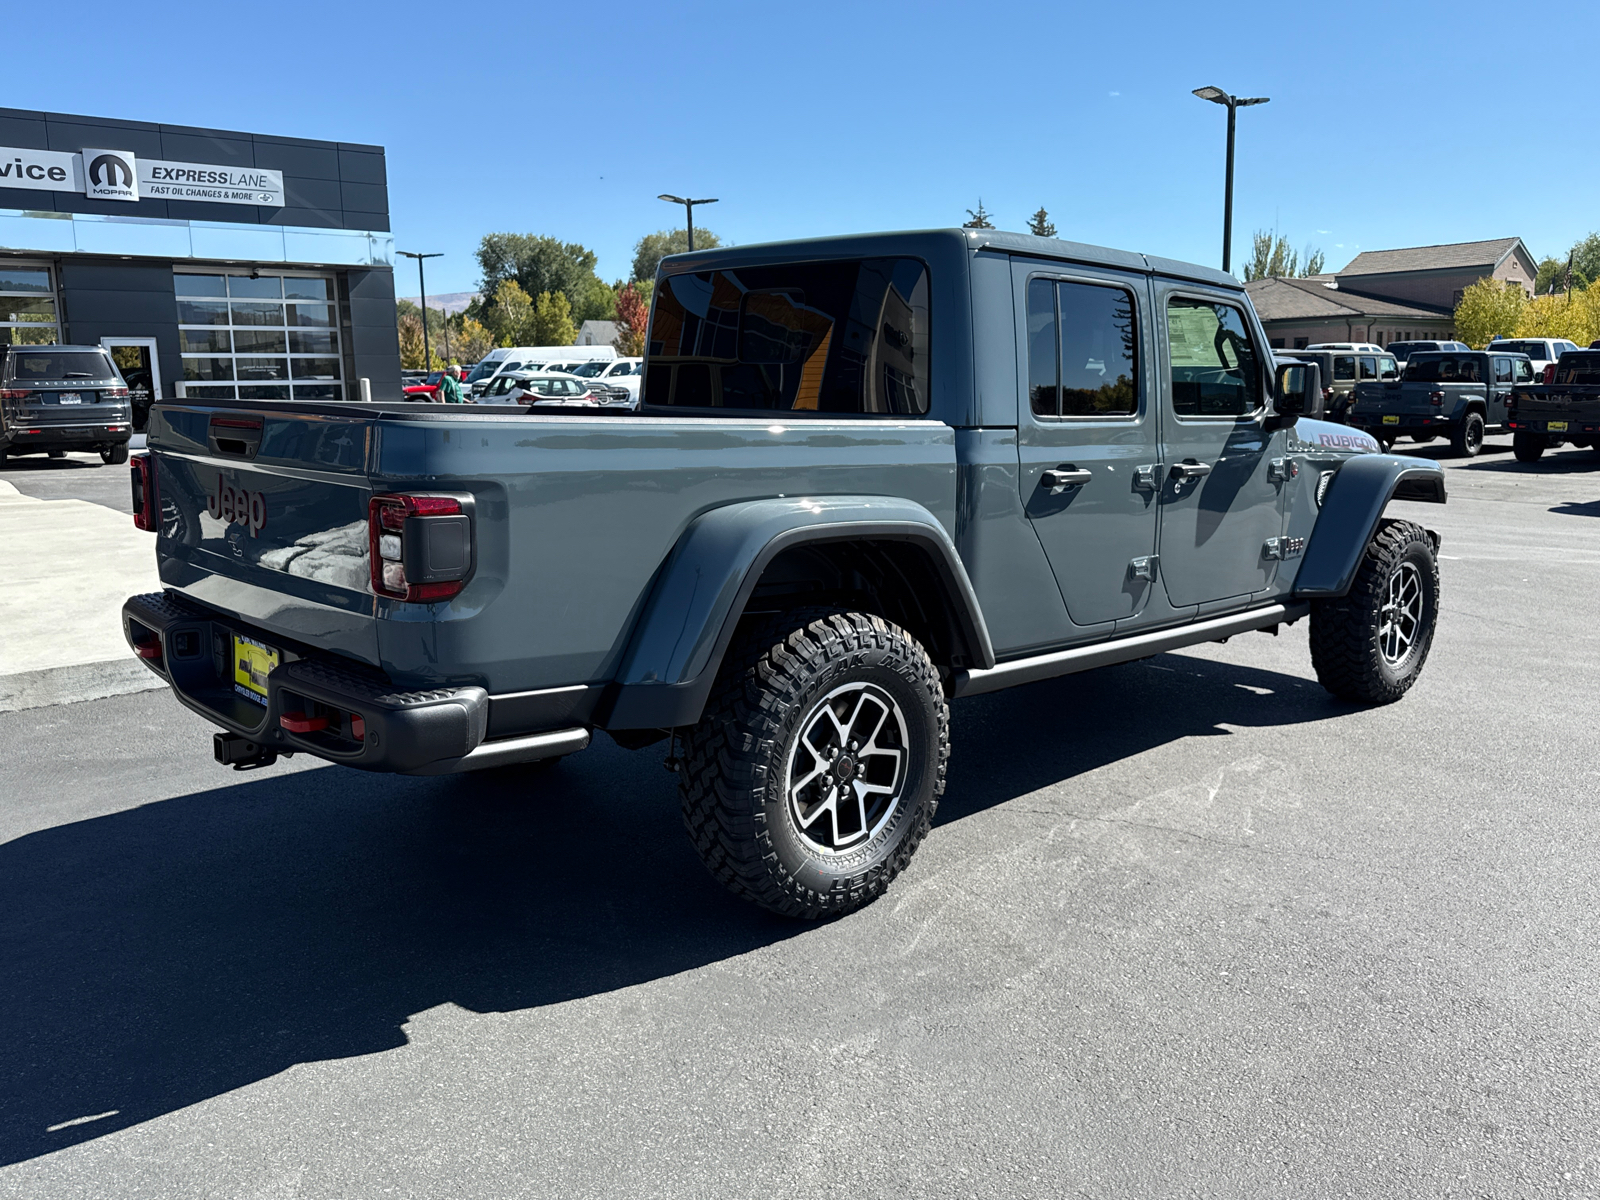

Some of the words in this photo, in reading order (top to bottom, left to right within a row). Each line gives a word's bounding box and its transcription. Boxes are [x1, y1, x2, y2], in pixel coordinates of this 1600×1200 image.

[150, 185, 170, 195] FAST
[171, 187, 184, 196] OIL
[185, 188, 222, 199] CHANGES
[231, 191, 253, 201] MORE
[1319, 433, 1378, 450] RUBICON
[206, 473, 266, 539] Jeep
